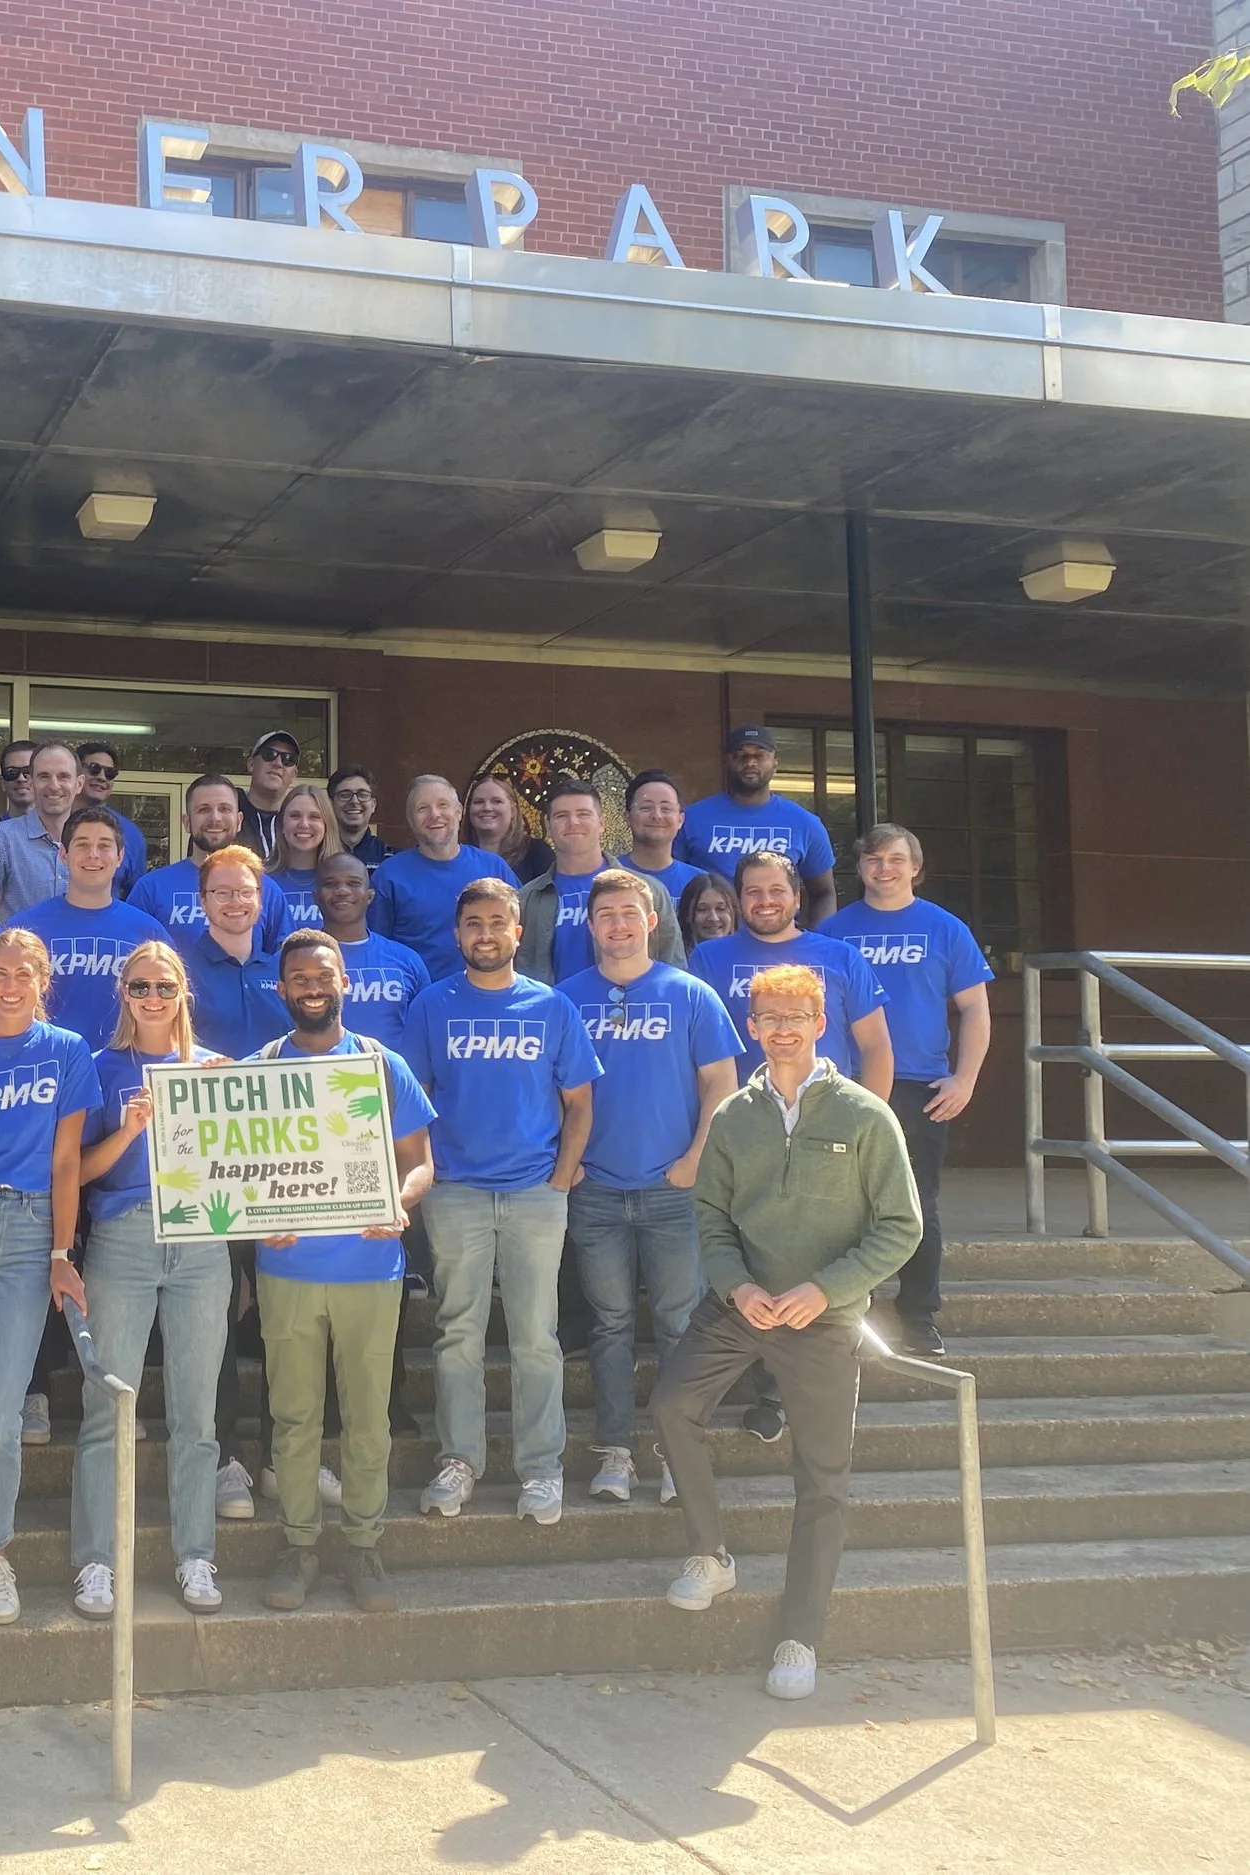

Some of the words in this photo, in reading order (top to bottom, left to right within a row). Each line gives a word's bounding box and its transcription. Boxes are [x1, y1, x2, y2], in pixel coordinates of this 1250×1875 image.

[464, 167, 950, 294] PARK
[708, 836, 788, 854] KPMG
[169, 905, 210, 925] KP
[555, 906, 589, 927] PM
[859, 944, 924, 965] PMG
[260, 981, 278, 990] KPM
[447, 1036, 542, 1061] KPMG
[168, 1074, 268, 1115] PITCH
[280, 1072, 315, 1110] IN
[173, 1123, 194, 1141] for
[198, 1115, 320, 1157] PARKS
[177, 1143, 194, 1156] the
[208, 1160, 325, 1183] happens
[267, 1177, 339, 1200] here!
[281, 1204, 316, 1213] VOLUNTEER
[316, 1203, 332, 1211] PARK
[361, 1200, 384, 1208] EFFORT
